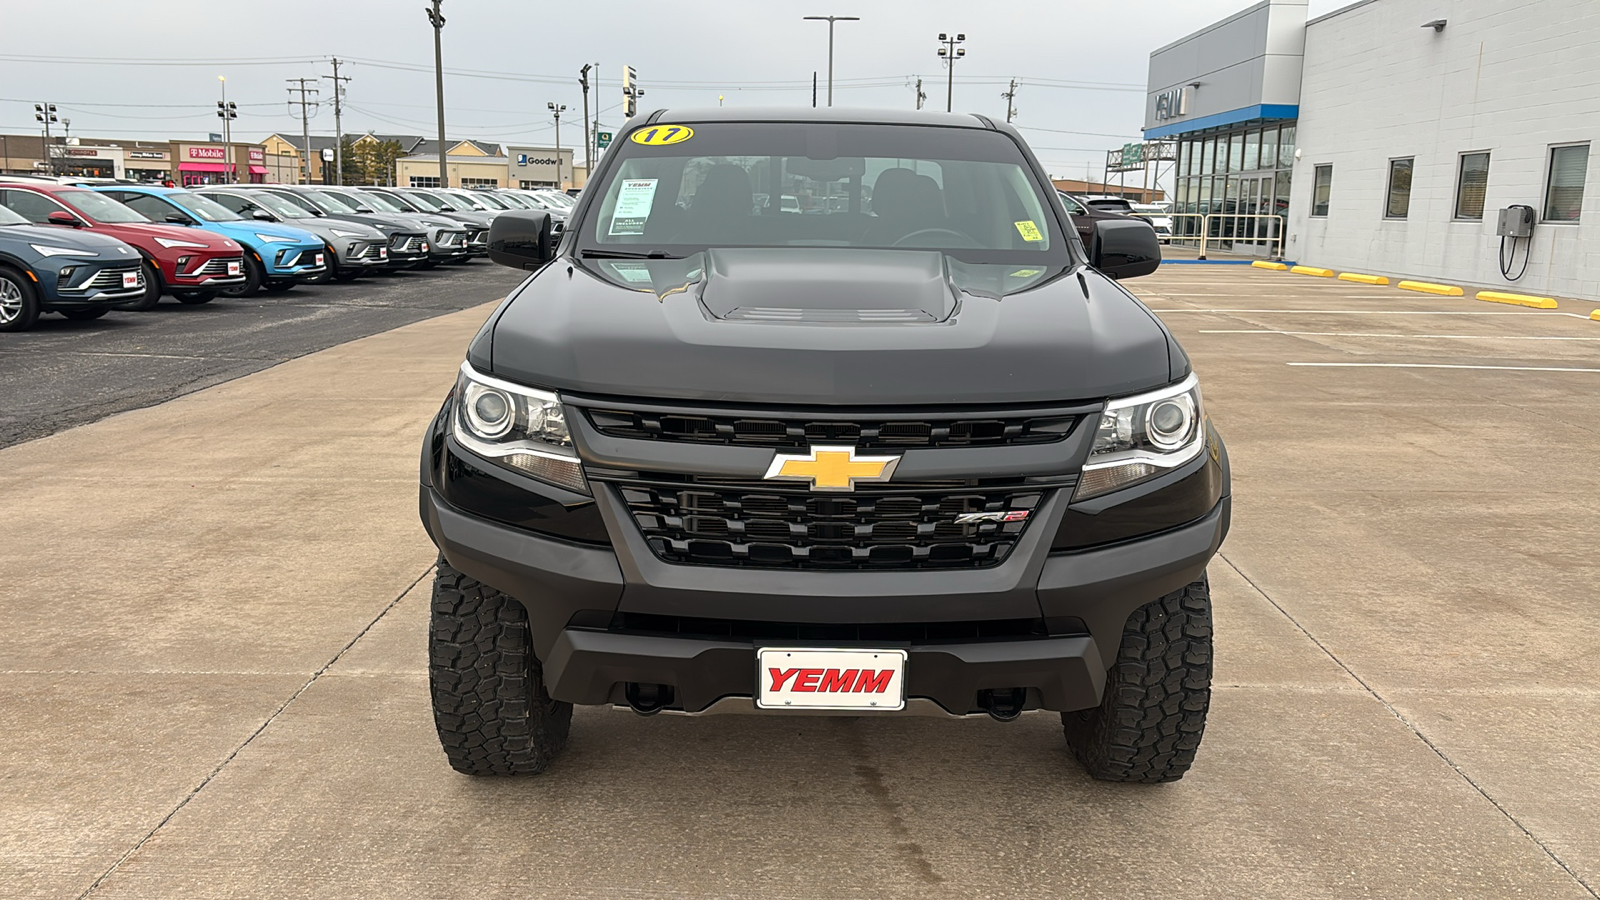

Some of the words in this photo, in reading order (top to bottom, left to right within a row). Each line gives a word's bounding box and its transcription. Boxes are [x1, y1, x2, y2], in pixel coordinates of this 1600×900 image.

[644, 128, 681, 142] 17
[198, 149, 224, 158] Mobile
[528, 157, 563, 165] Goodwl
[953, 510, 1030, 524] ZR2
[768, 667, 895, 693] YEMM
